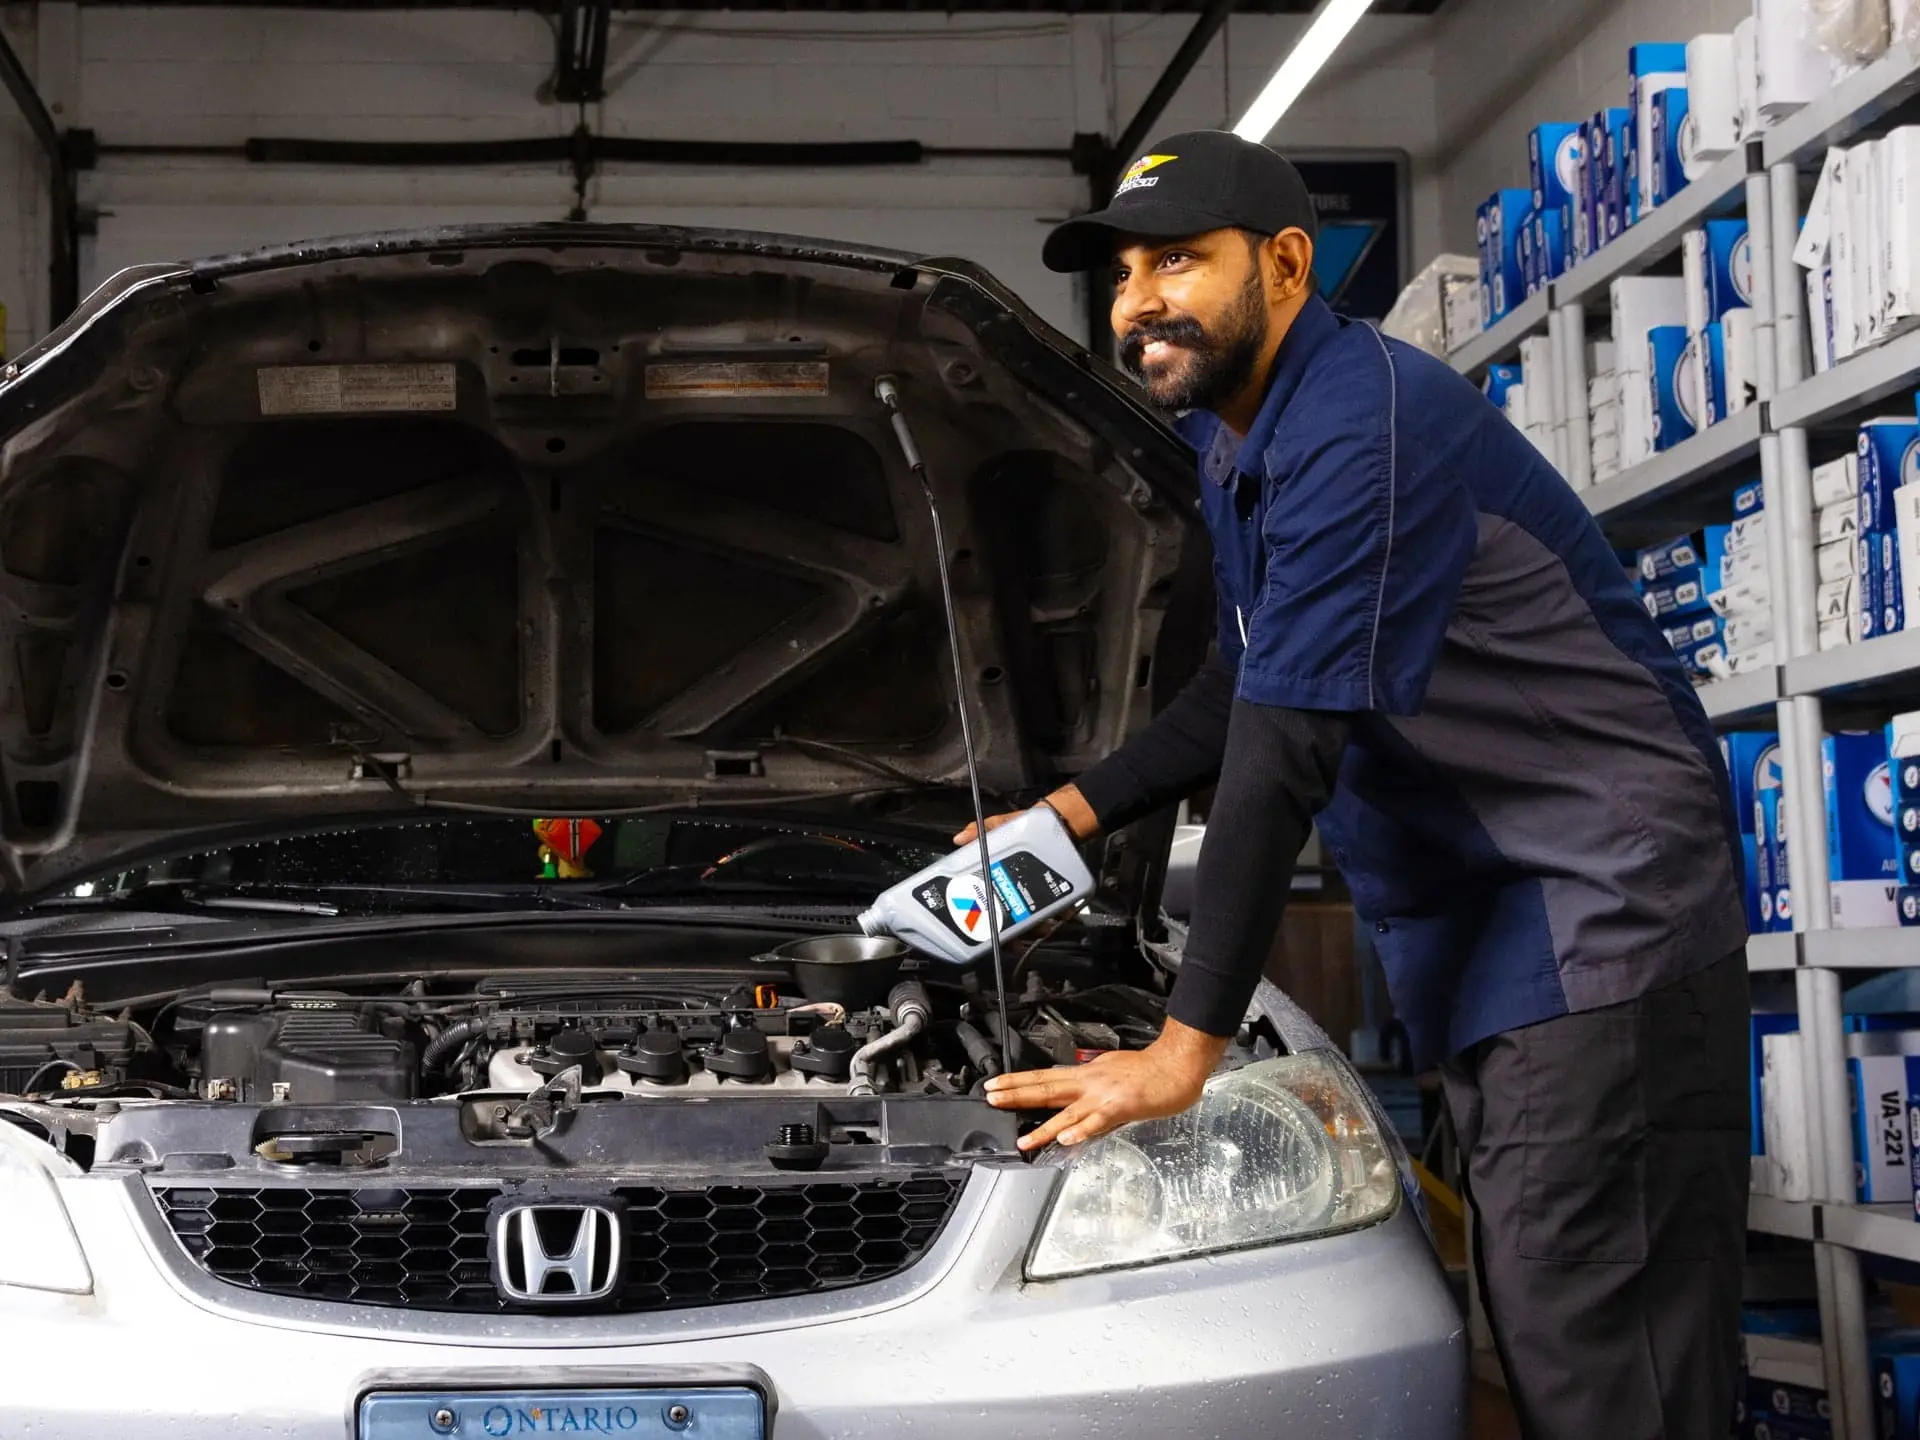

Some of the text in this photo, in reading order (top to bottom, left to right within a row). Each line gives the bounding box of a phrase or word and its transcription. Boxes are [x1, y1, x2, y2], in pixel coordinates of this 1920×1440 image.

[992, 866, 1025, 916] EUROPEAN
[1880, 1090, 1906, 1167] VA-221
[484, 1404, 637, 1436] ONTARIO
